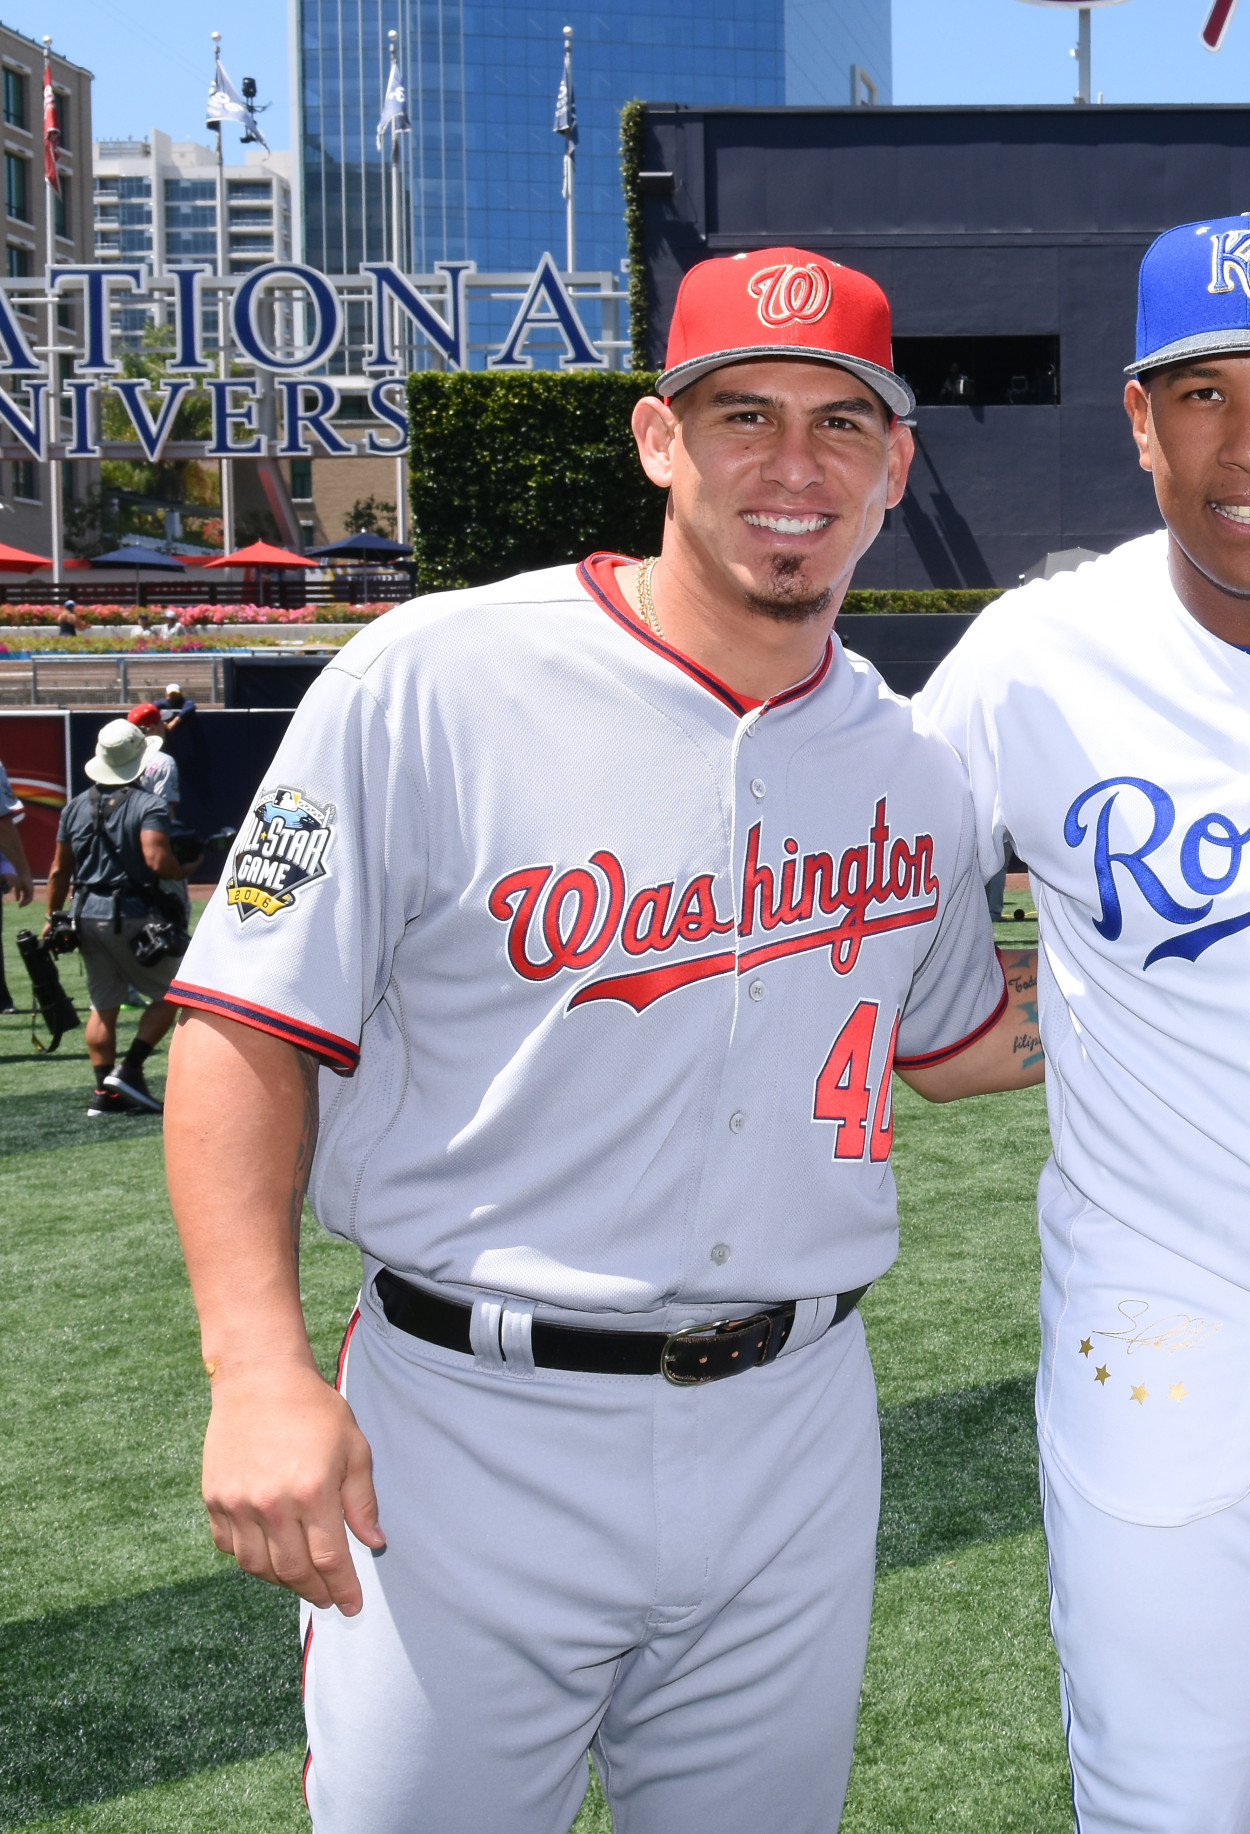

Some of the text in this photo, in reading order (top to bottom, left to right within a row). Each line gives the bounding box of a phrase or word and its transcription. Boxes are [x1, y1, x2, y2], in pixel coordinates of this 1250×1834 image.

[0, 252, 633, 374] TIONA
[748, 263, 832, 328] W
[237, 853, 291, 890] GAME
[261, 816, 331, 876] STAR
[234, 890, 271, 908] 2016
[488, 794, 939, 983] Washington
